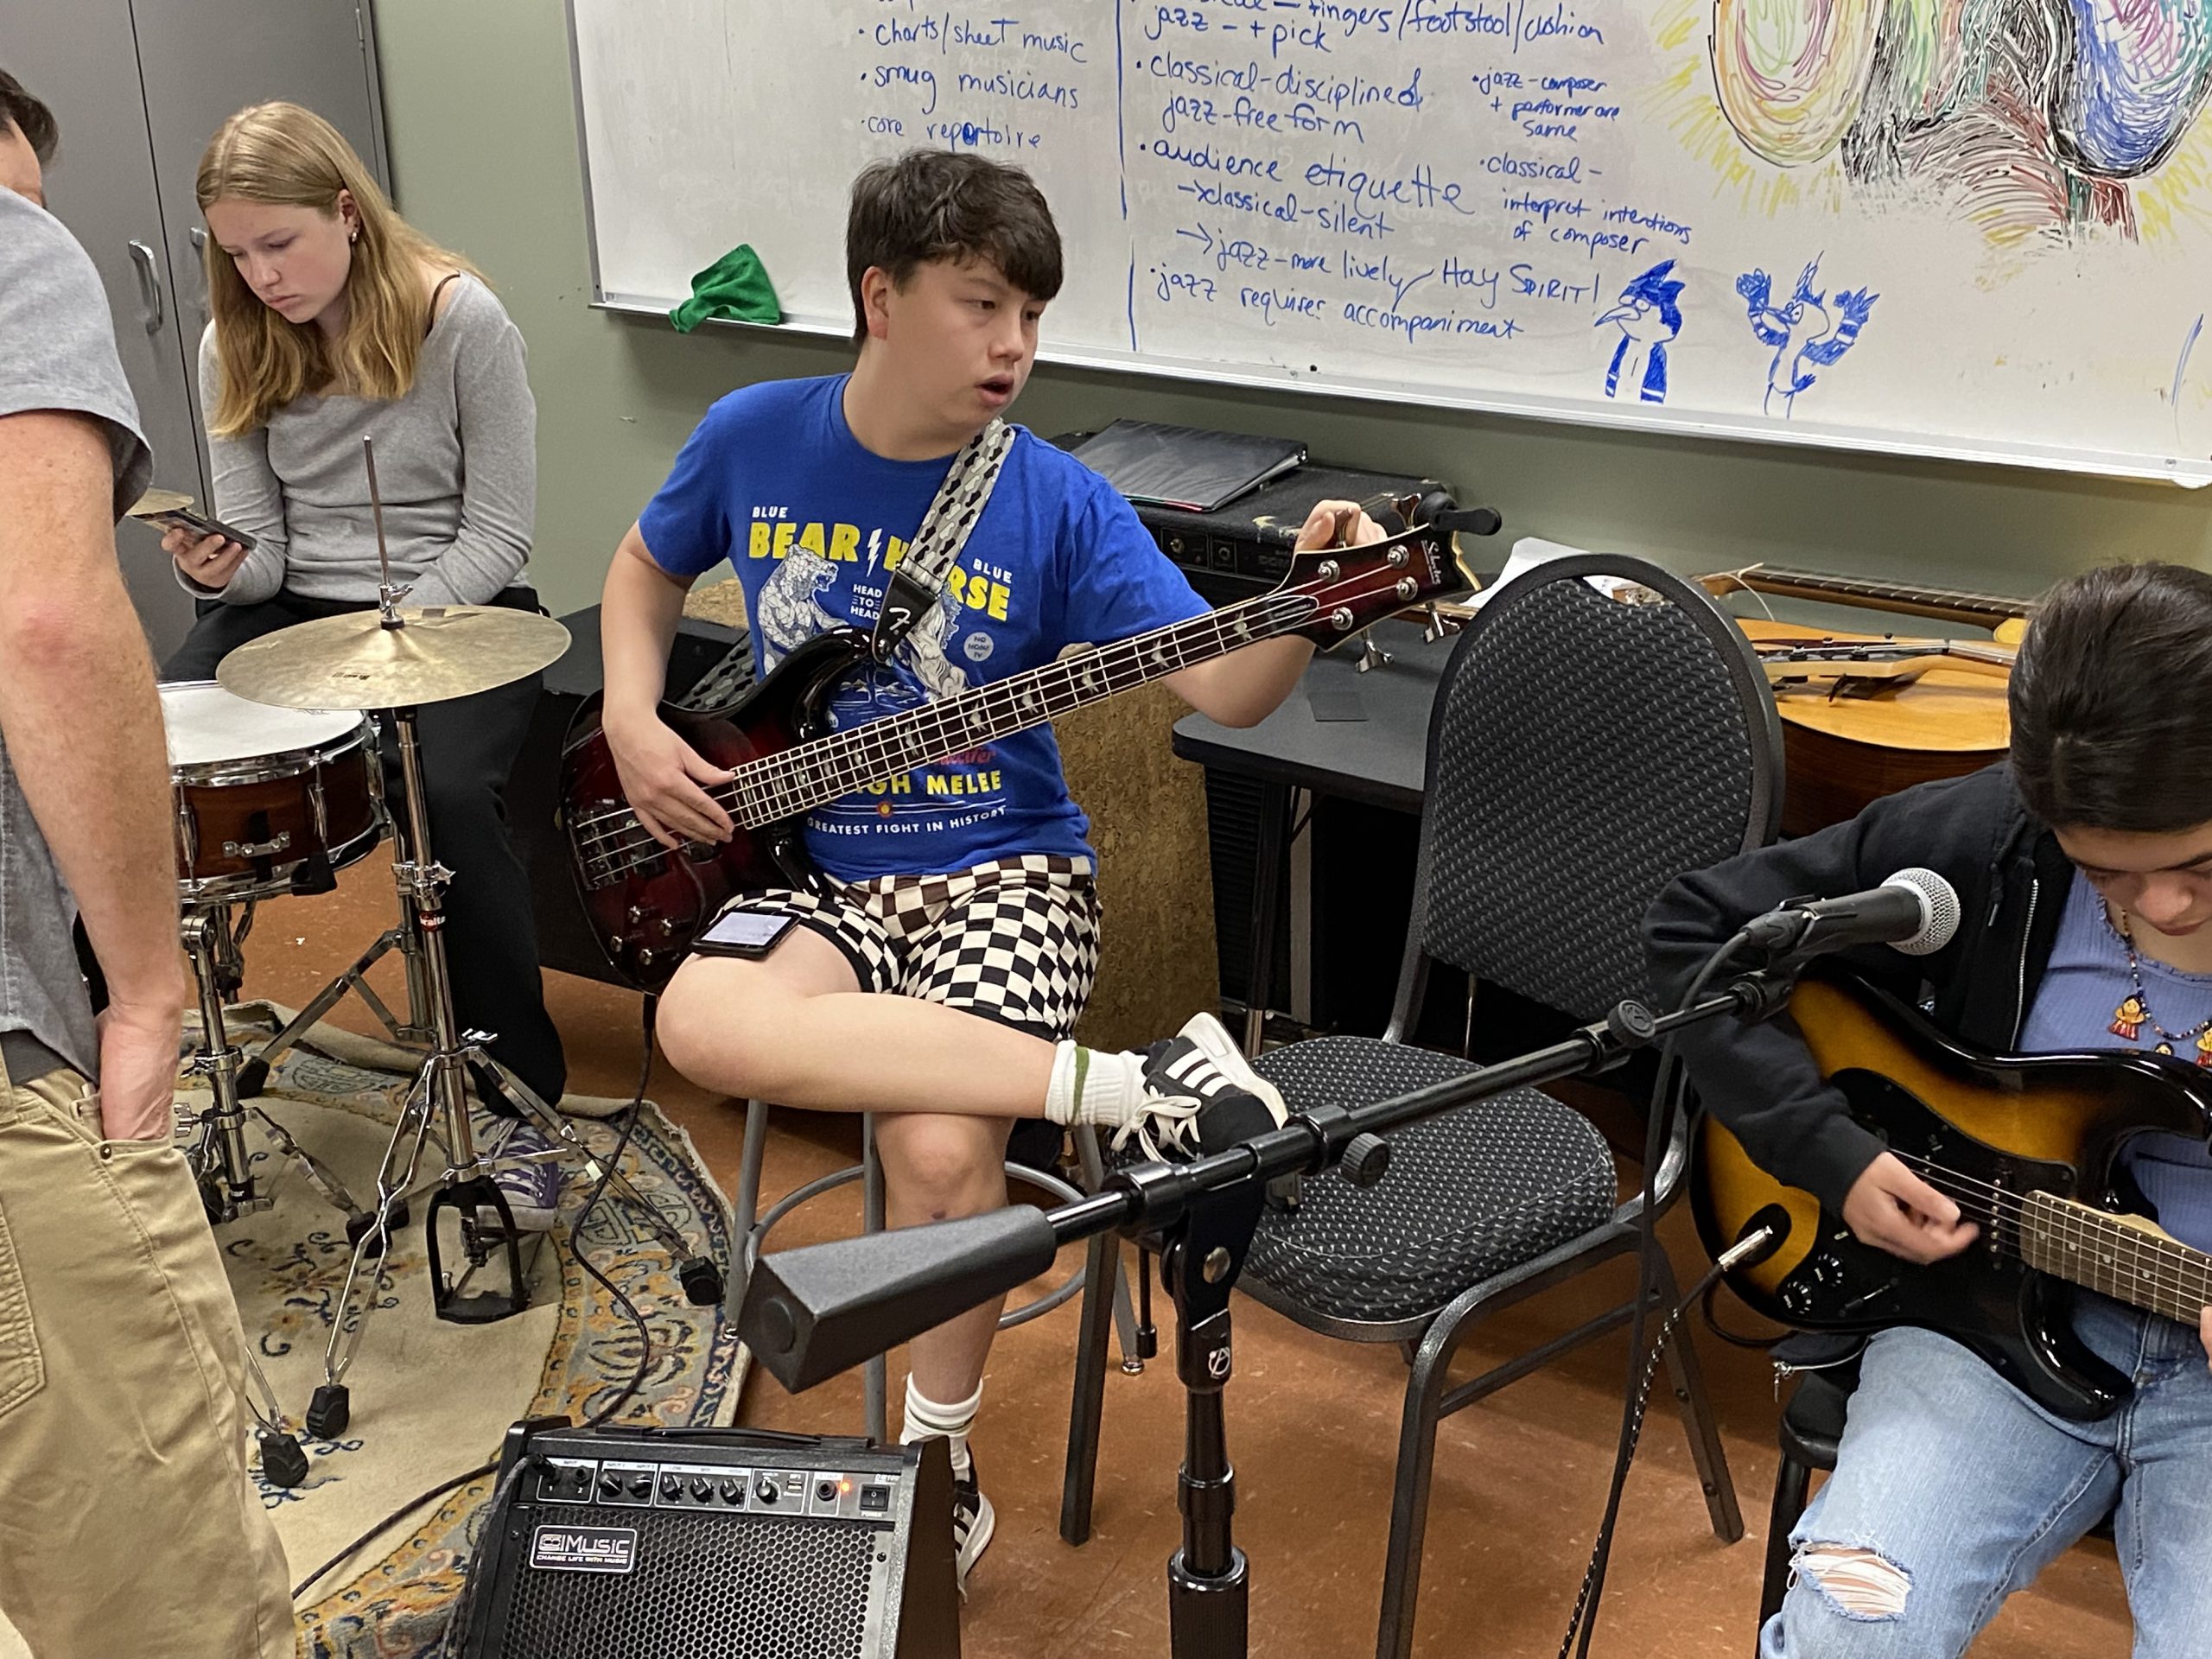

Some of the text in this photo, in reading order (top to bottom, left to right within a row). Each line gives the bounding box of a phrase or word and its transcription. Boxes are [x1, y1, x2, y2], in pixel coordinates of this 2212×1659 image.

[1144, 5, 1210, 41] jazz
[1022, 32, 1087, 63] music
[874, 64, 1078, 115] smug musicians
[868, 118, 905, 137] core
[1594, 106, 1620, 122] are
[1153, 138, 1476, 219] audience etiquette
[1601, 199, 1693, 245] intentions
[1513, 219, 1650, 260] of composer
[1442, 256, 1500, 309] Hay
[1156, 263, 1217, 302] jazz
[1344, 302, 1526, 344] accompaniment
[752, 505, 789, 518] BLUE
[748, 521, 1011, 622] BEAR HRSE
[972, 557, 1013, 584] BLUE
[852, 583, 883, 599] HEAD
[859, 598, 874, 609] TO
[849, 606, 881, 621] HEAD
[926, 770, 1001, 796] MELEE
[807, 804, 1007, 835] GREATEST FIGHT IN HISTORY
